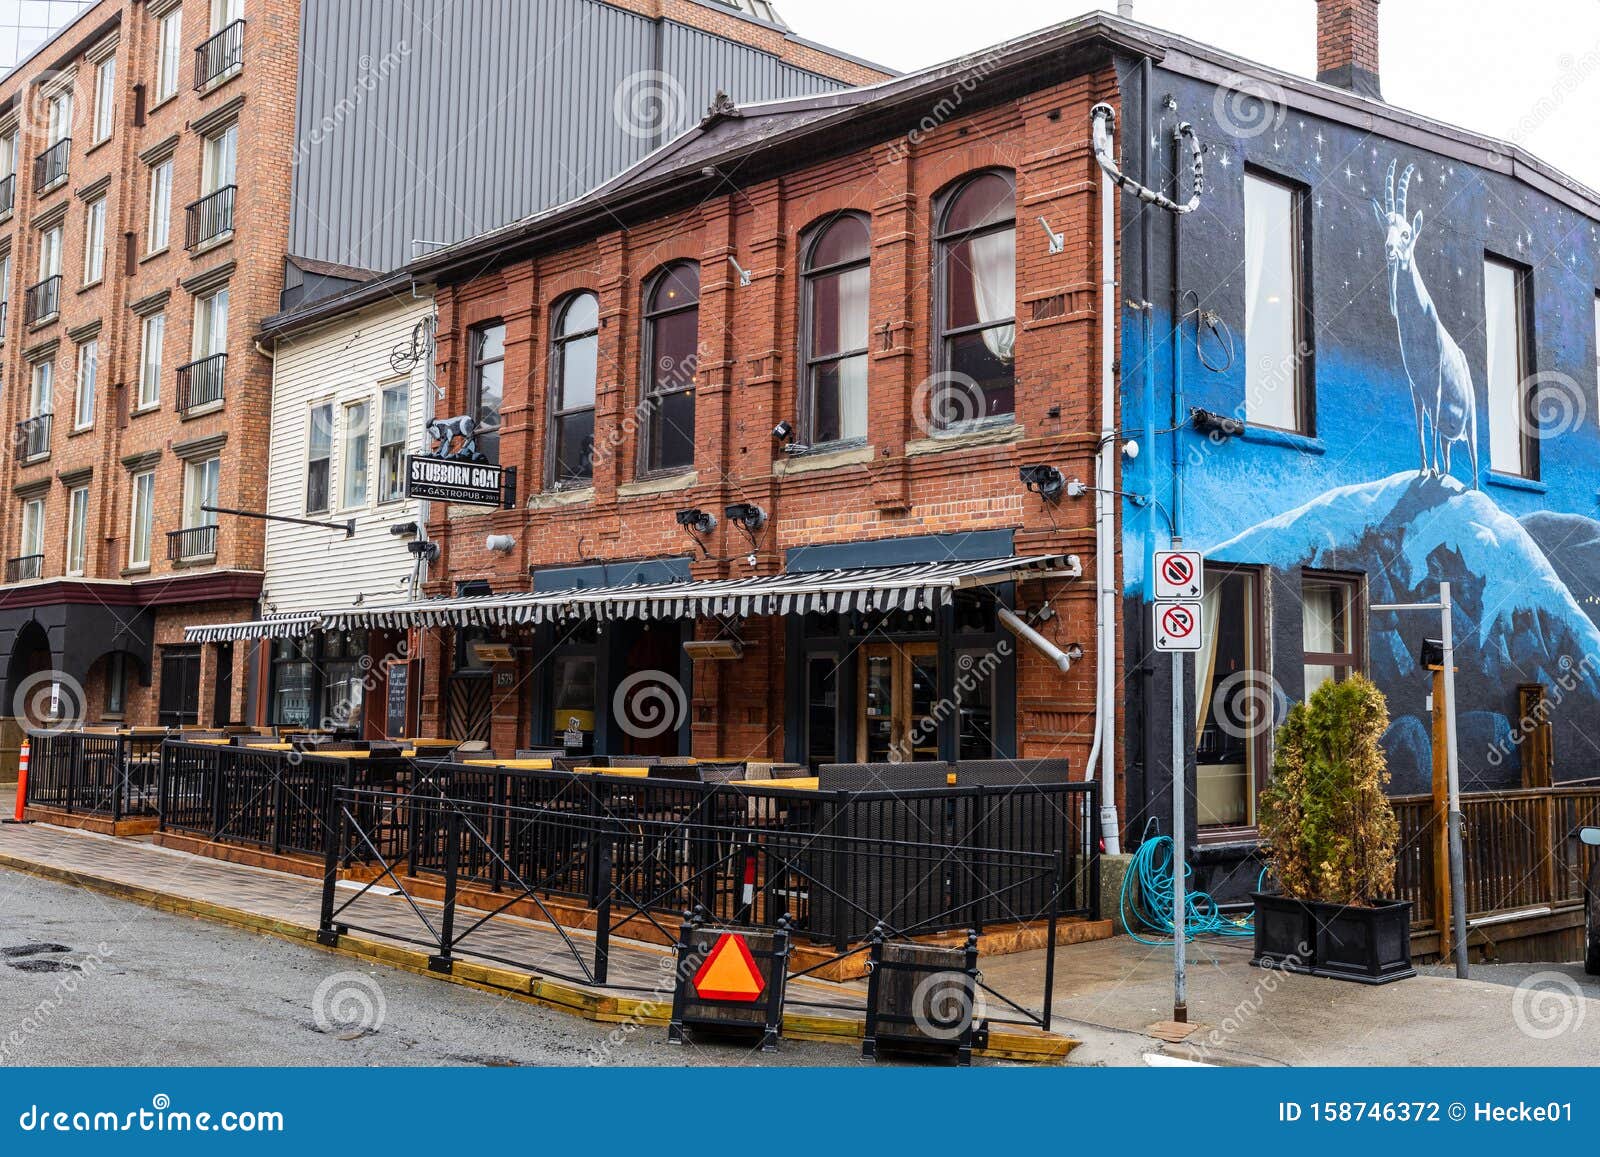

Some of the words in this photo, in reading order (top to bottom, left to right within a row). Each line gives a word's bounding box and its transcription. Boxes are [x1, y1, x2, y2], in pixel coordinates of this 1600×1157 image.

[412, 461, 470, 485] STUBBORN
[472, 468, 500, 489] GOAT
[428, 487, 480, 500] GASTROPUB
[497, 673, 513, 685] 1579
